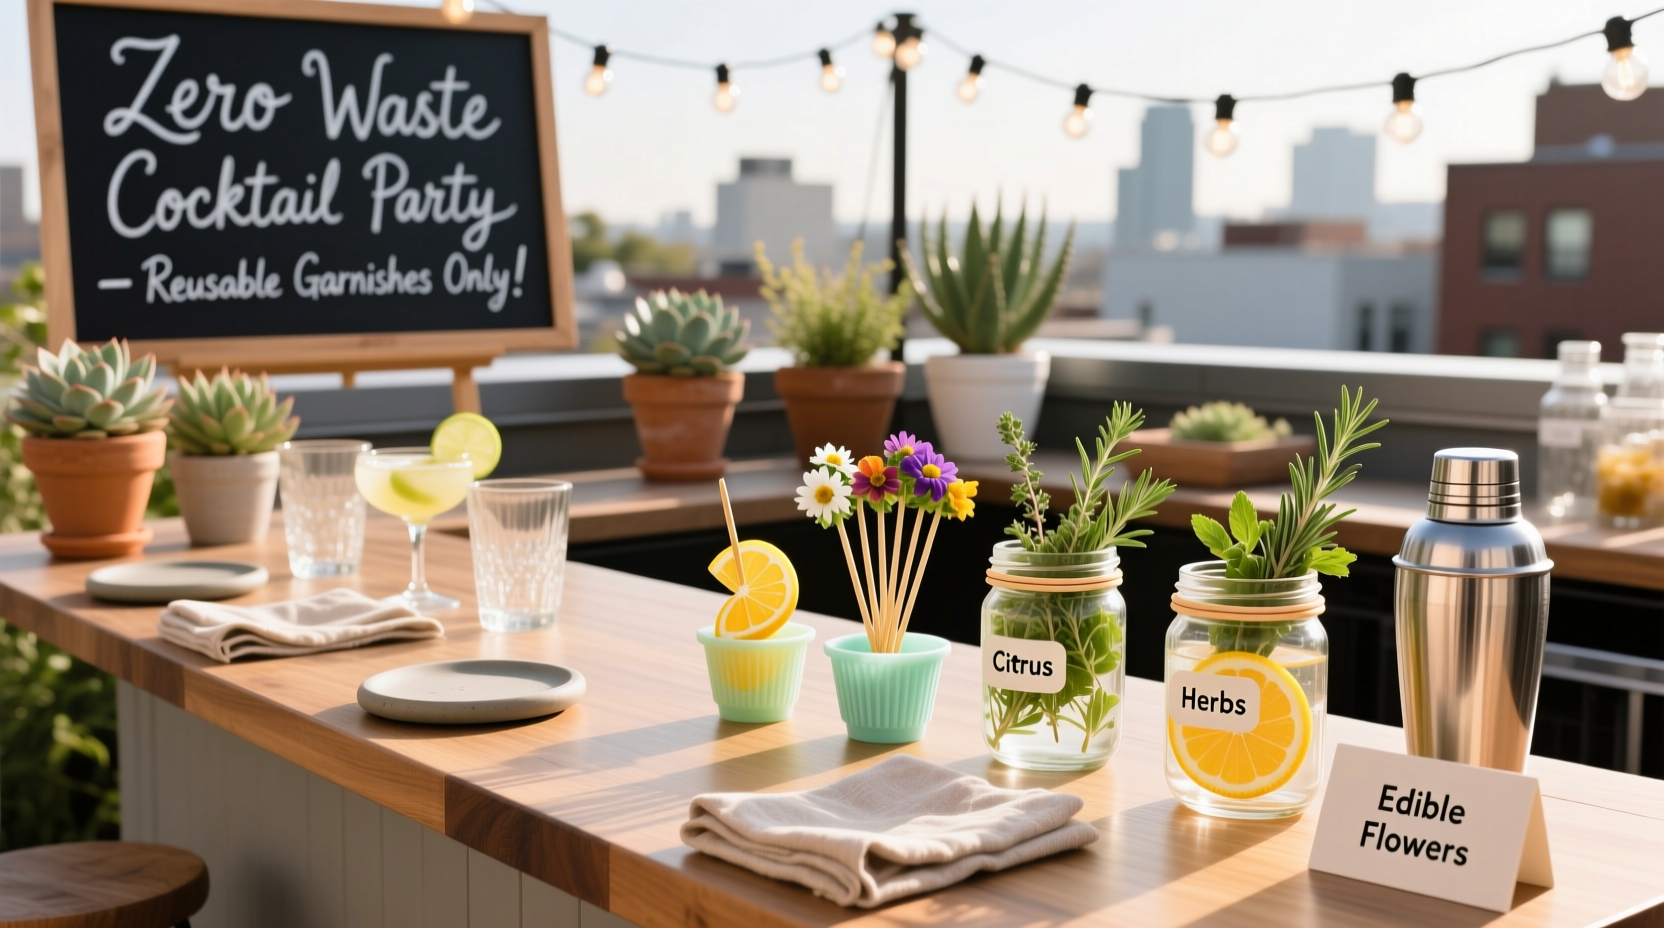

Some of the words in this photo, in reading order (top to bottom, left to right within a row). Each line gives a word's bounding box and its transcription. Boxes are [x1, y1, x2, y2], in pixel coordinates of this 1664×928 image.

[104, 34, 292, 145] Zero
[302, 49, 500, 141] Waste
[107, 149, 343, 238] Cocktail
[362, 153, 518, 252] Party
[141, 254, 283, 304] Reusable
[294, 252, 432, 300] Garnishes
[444, 244, 527, 313] Only!
[992, 650, 1053, 677] Citrus
[1181, 686, 1247, 716] Herbs
[1378, 784, 1466, 825] Edible
[1360, 820, 1469, 866] Flowers
